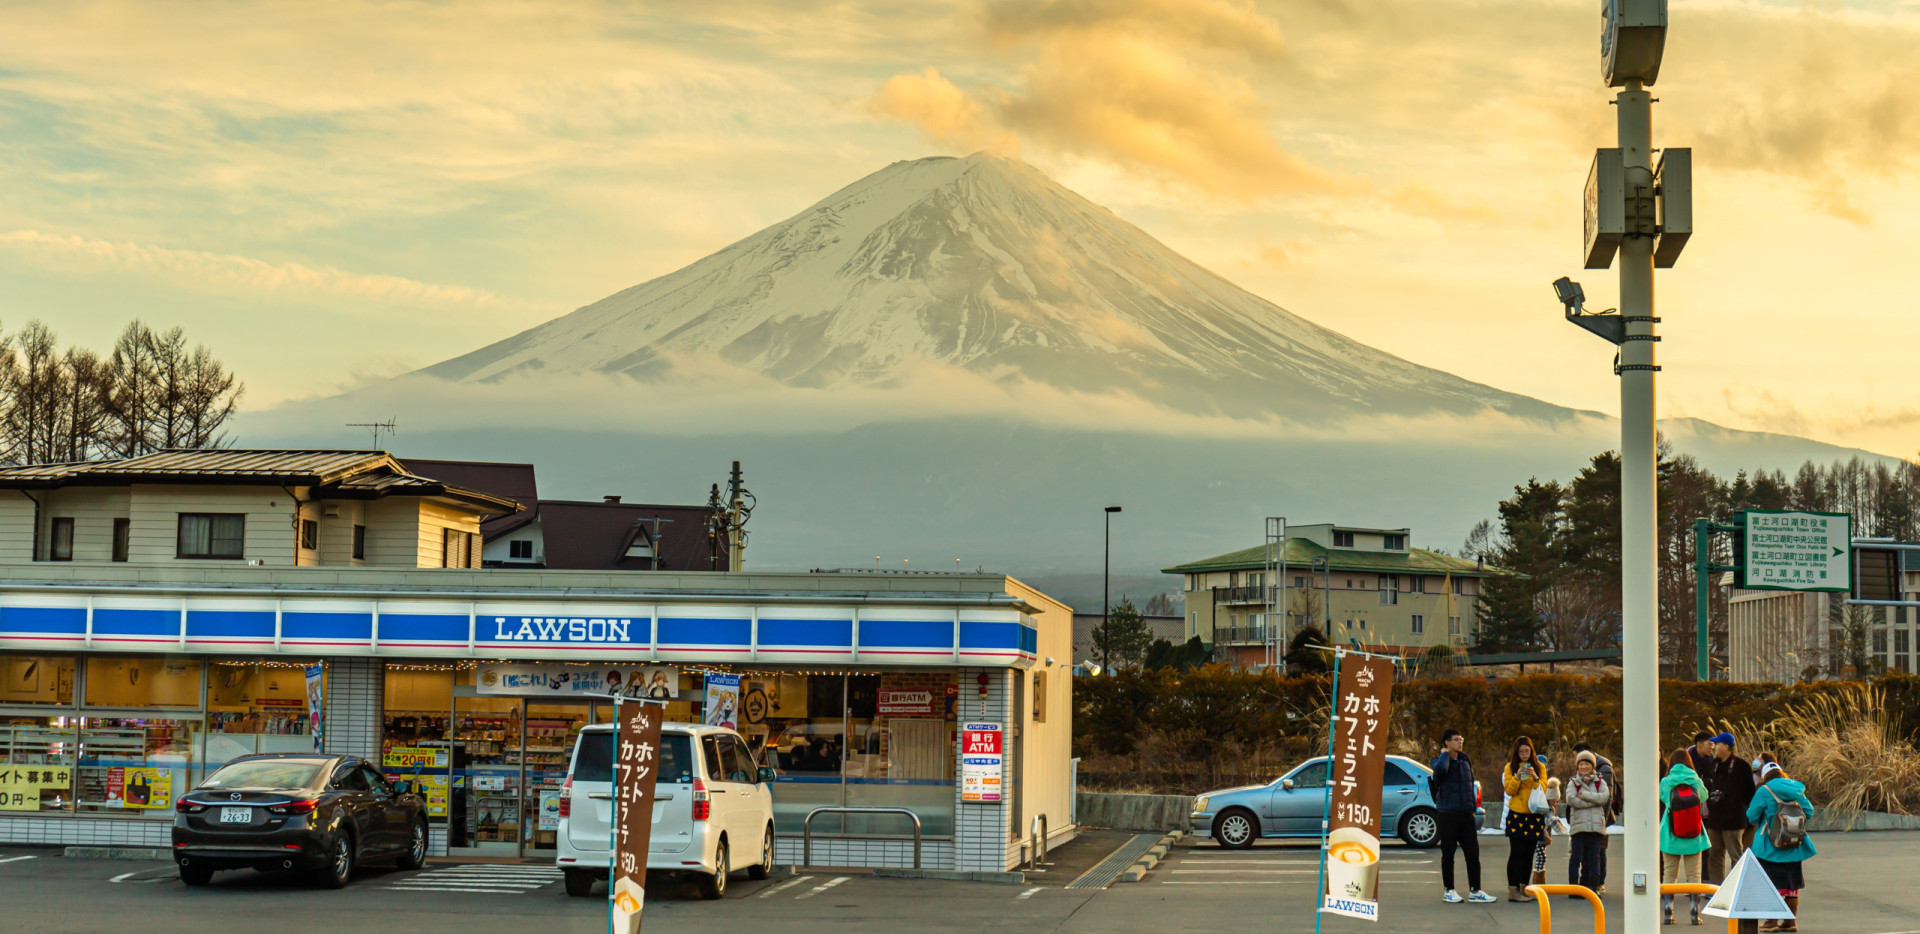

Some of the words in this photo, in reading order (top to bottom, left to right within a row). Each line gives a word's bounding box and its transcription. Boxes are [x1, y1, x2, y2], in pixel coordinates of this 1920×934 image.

[495, 617, 631, 642] LAWSON
[710, 676, 739, 685] LAWSON
[1362, 695, 1380, 757] ホット
[971, 733, 994, 743] 銀行
[1341, 692, 1361, 796] カフェラテ
[969, 743, 994, 752] ATM
[402, 754, 435, 766] 20円引
[633, 742, 654, 803] ホット
[621, 740, 634, 844] カフェラテ
[227, 813, 250, 822] 26-33
[1327, 898, 1375, 915] LAWSON
